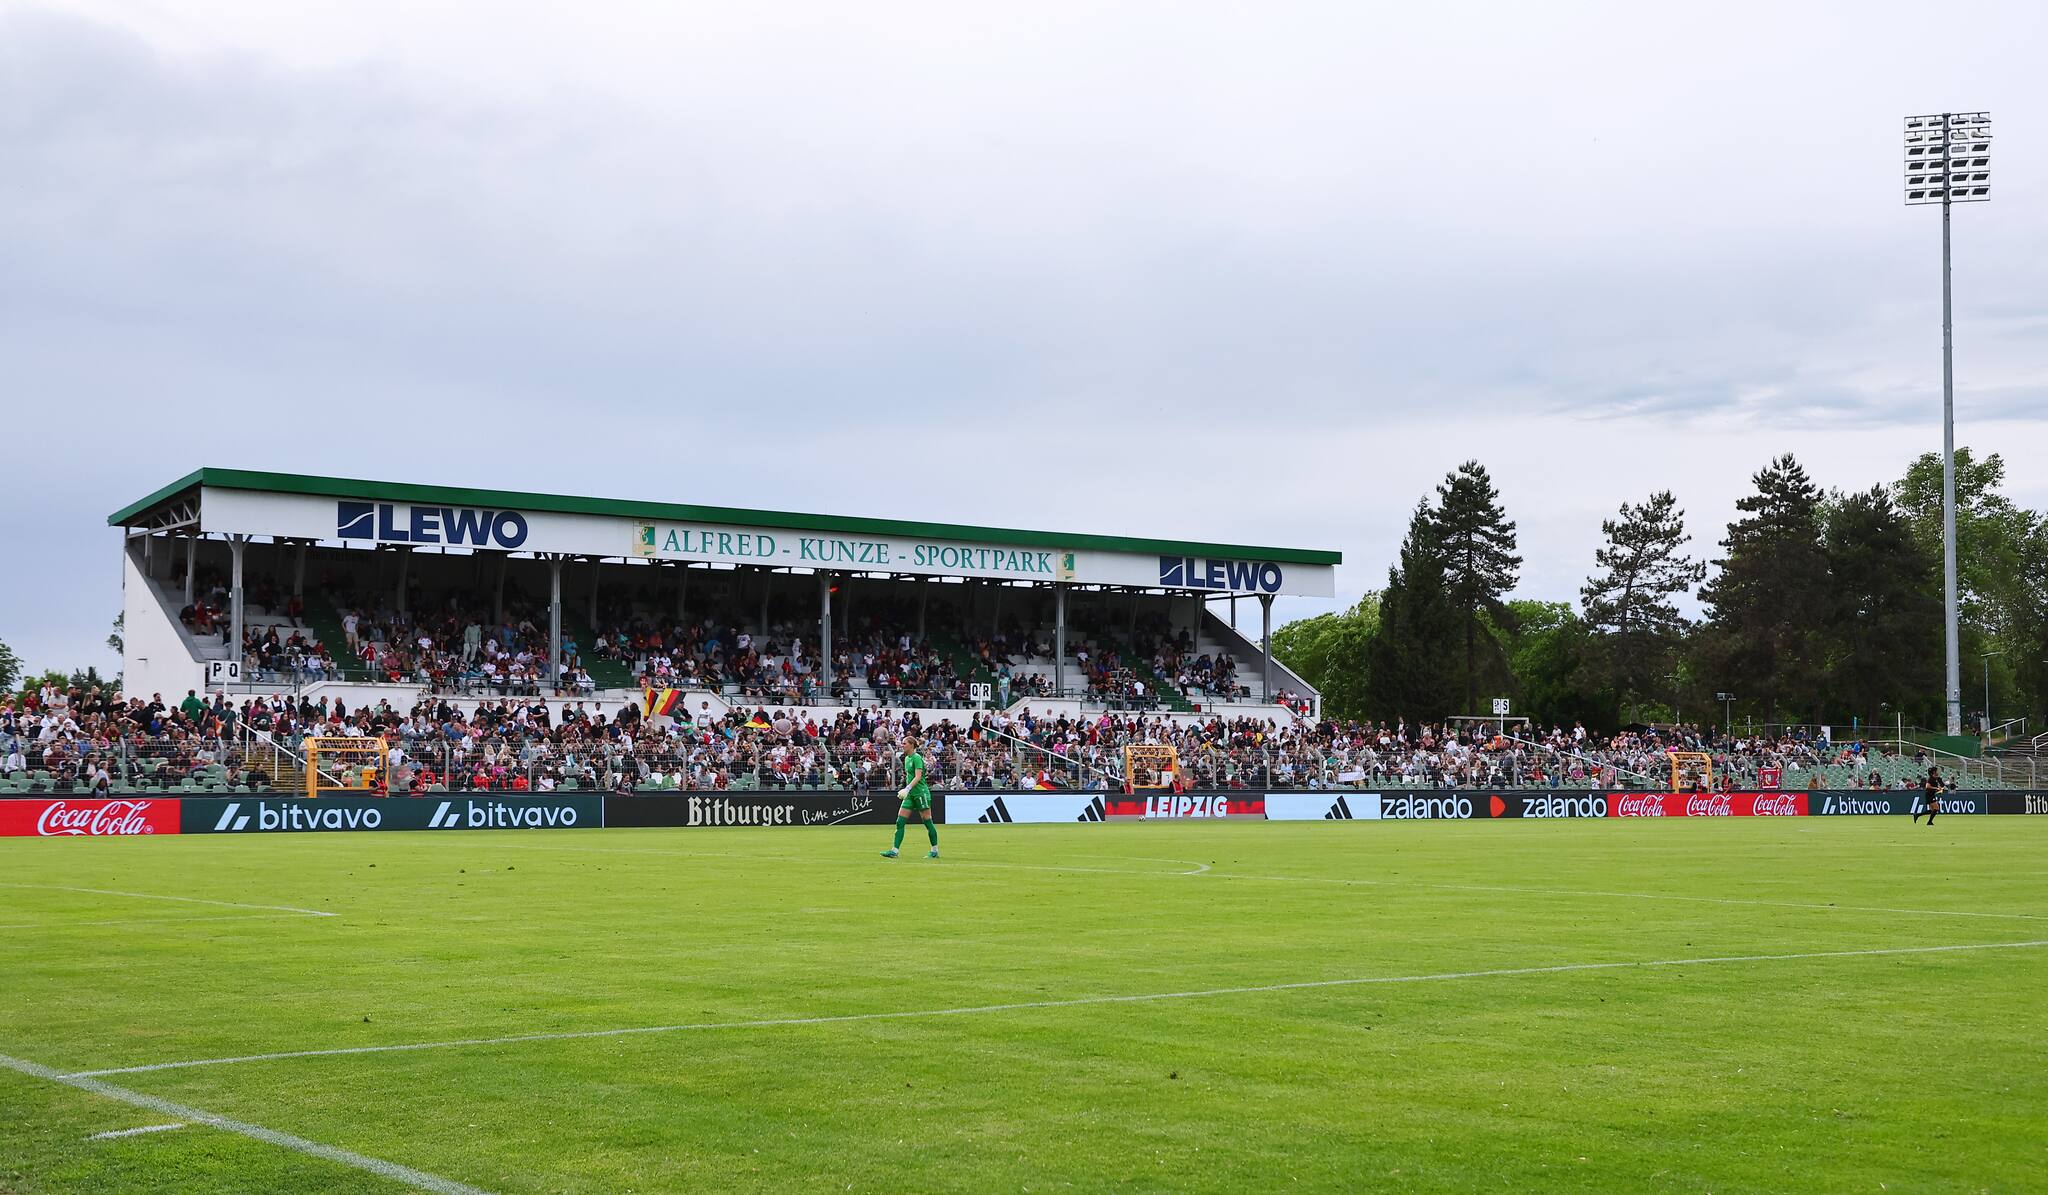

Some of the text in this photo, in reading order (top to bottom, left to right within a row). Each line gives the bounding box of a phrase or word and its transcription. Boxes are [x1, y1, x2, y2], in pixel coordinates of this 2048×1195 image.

[379, 504, 528, 549] LEWO
[662, 529, 776, 557] ALFRED
[800, 538, 890, 564] KUNZE
[913, 544, 1053, 573] SPORTPARK
[1186, 558, 1282, 592] LEWO
[213, 662, 239, 677] P Q
[1502, 700, 1508, 711] S
[260, 802, 382, 829] bitvavo
[468, 800, 577, 827] bitvavo
[686, 796, 794, 826] Bitburger
[801, 797, 872, 825] Bitte ein Bit
[1145, 795, 1228, 818] LEIPZIG
[1382, 794, 1473, 819] zalando
[1522, 794, 1607, 818] zalando
[1618, 794, 1664, 817] Coca-Cola
[1686, 794, 1732, 816] Coca-Cola
[1753, 794, 1796, 816] Coca-Cola
[1839, 796, 1890, 814] bitvavo
[37, 801, 152, 835] Coca-Cola
